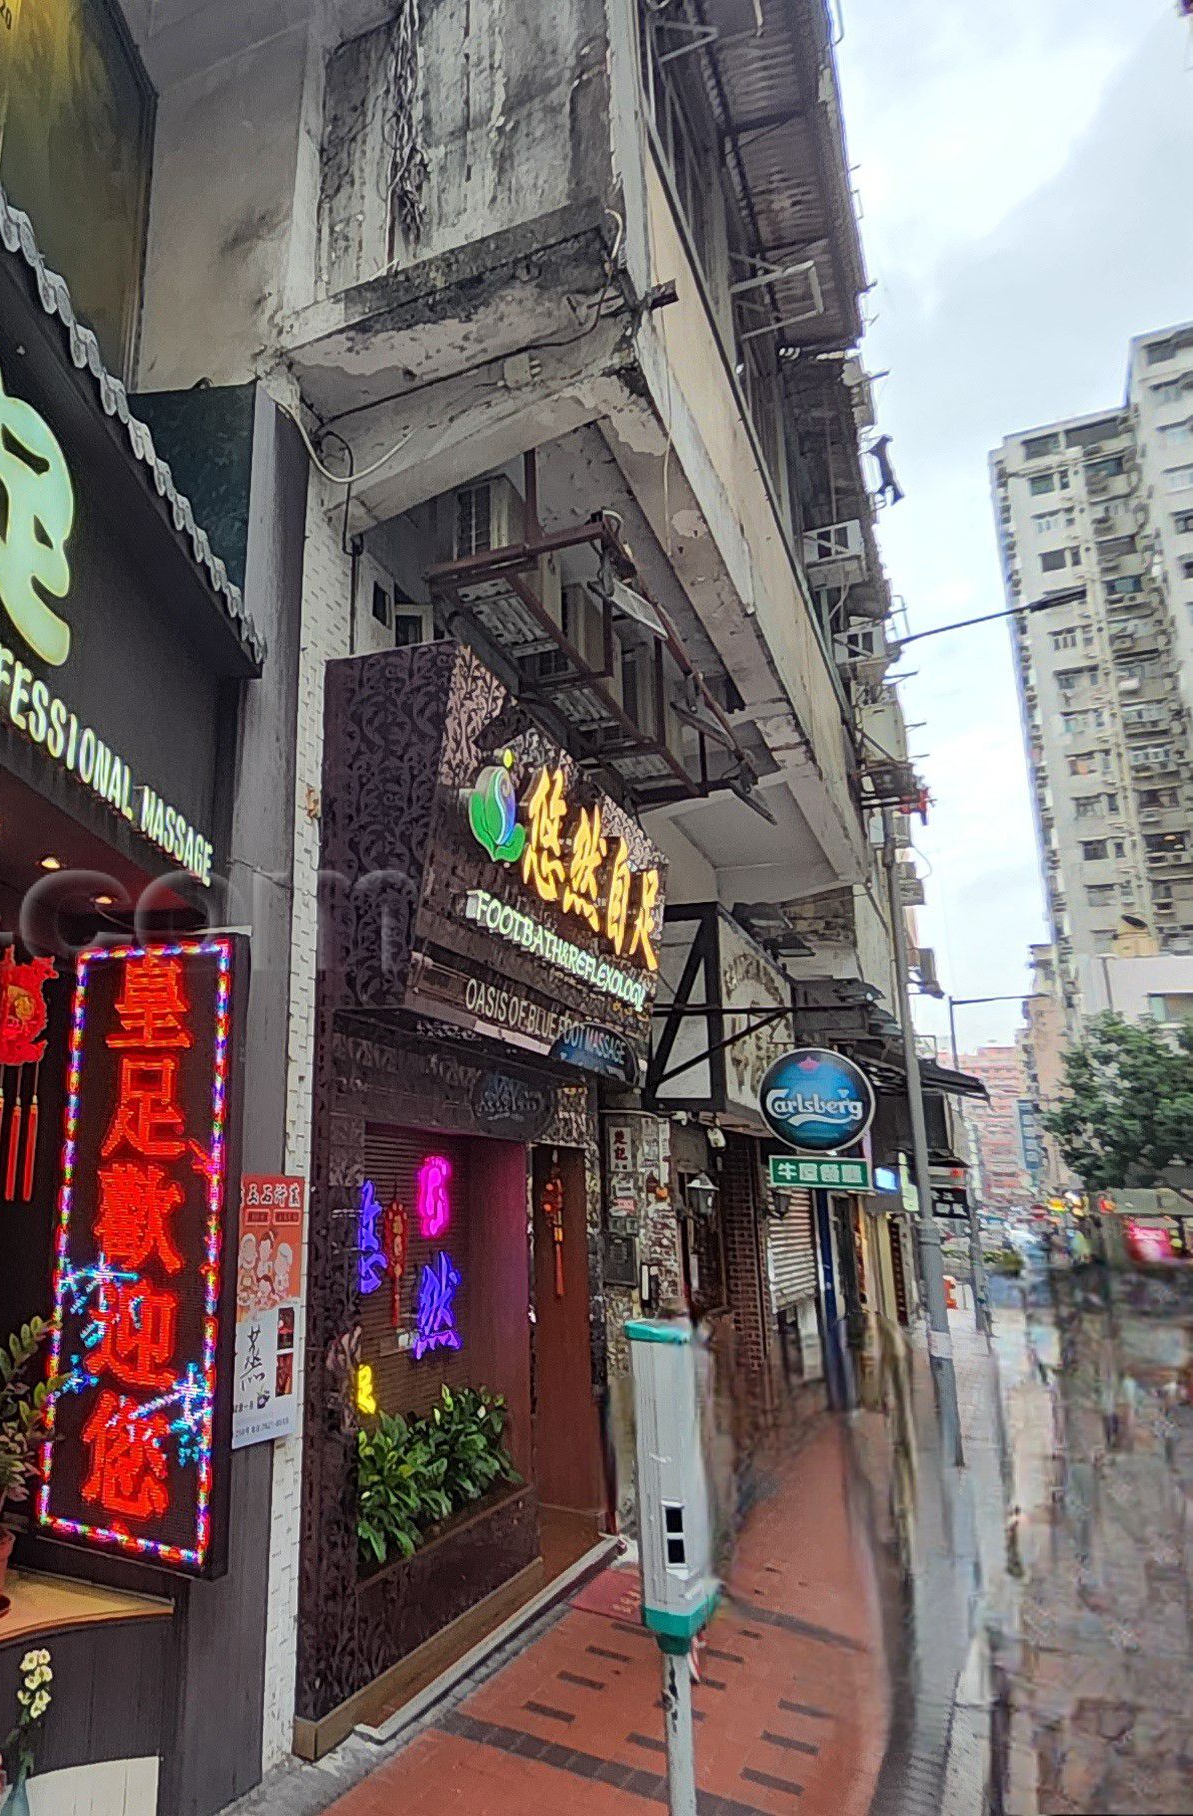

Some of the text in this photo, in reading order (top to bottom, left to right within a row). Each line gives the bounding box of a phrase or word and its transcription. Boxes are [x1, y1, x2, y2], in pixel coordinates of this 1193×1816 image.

[140, 785, 213, 888] MASSAGE
[465, 978, 508, 1023] OASIS
[508, 996, 527, 1027] OF
[527, 1005, 557, 1041] BLUE
[766, 1088, 863, 1120] Carlsberg
[81, 954, 192, 1522] 皇足歡迎您
